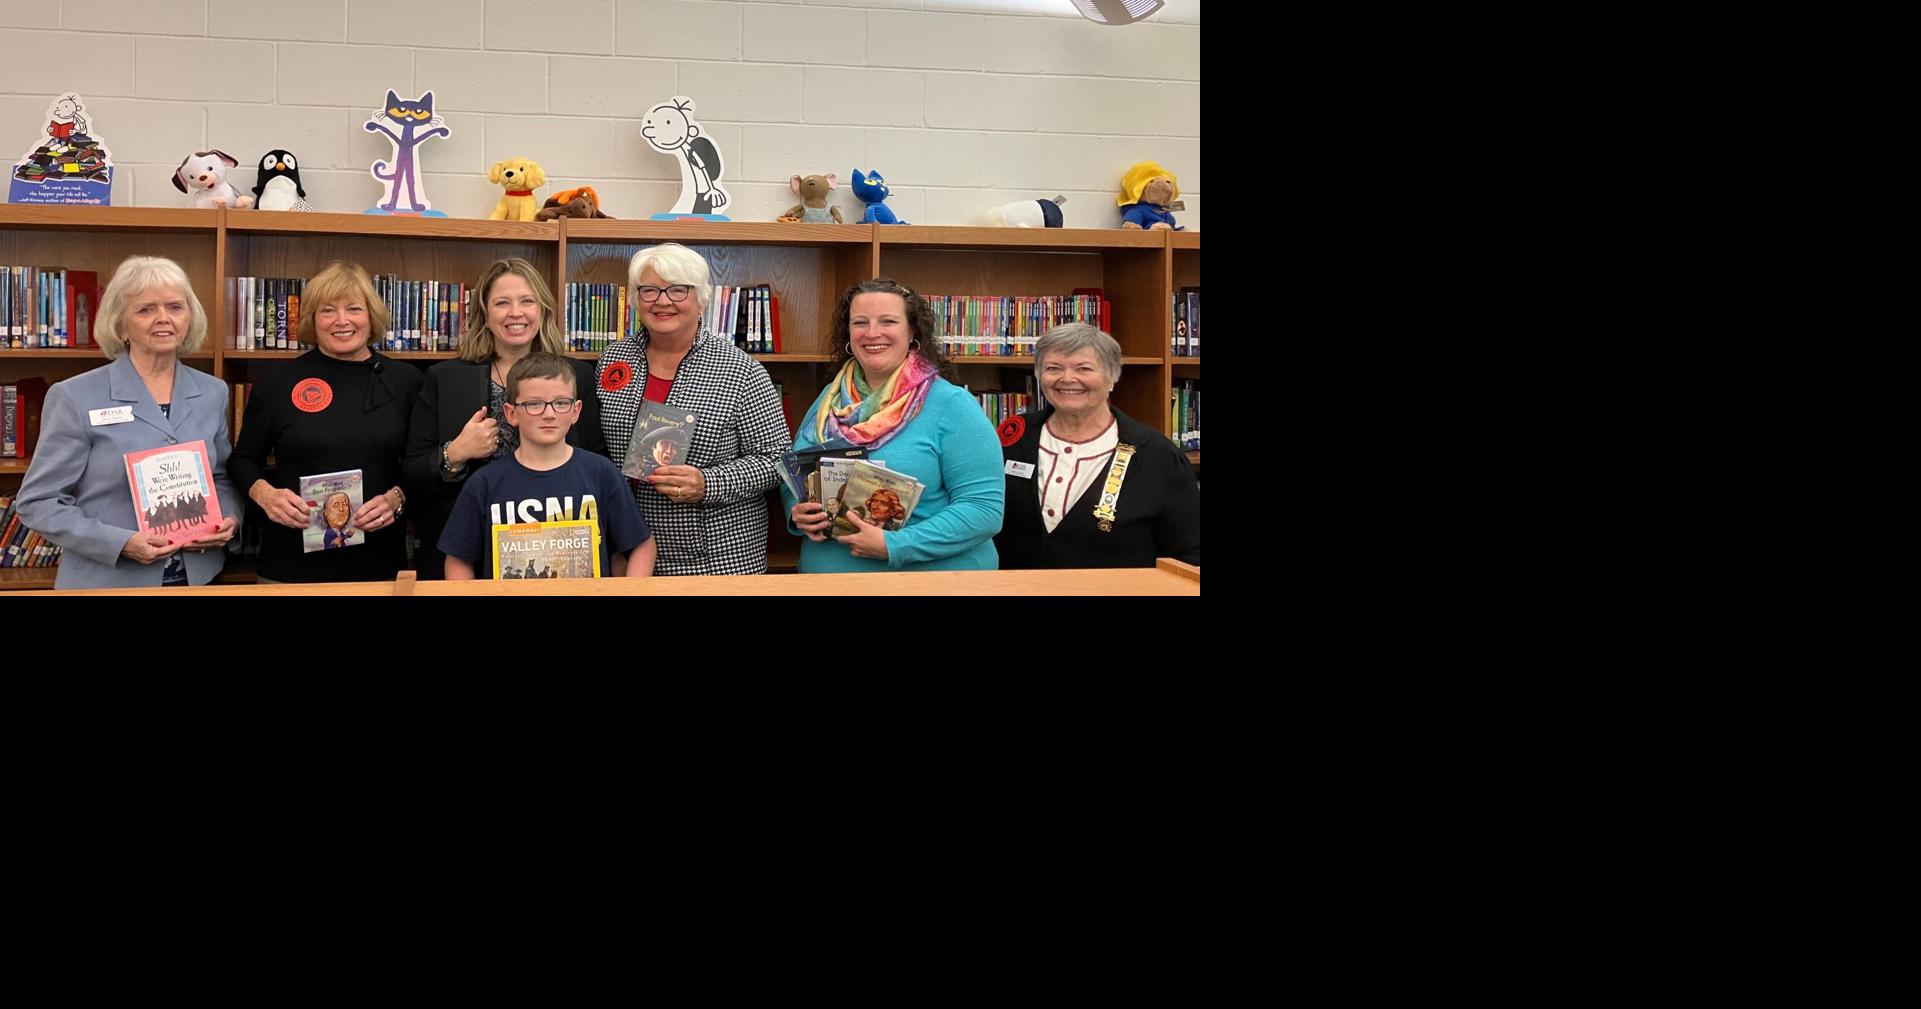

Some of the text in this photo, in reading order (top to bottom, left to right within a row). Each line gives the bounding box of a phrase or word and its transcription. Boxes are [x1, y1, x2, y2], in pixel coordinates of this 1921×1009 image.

[277, 301, 287, 339] TORN
[159, 460, 181, 474] Shh!
[168, 472, 192, 481] Writing
[159, 479, 198, 491] Constitution
[490, 494, 599, 525] USNA
[501, 537, 589, 553] VALLEY FORGE
